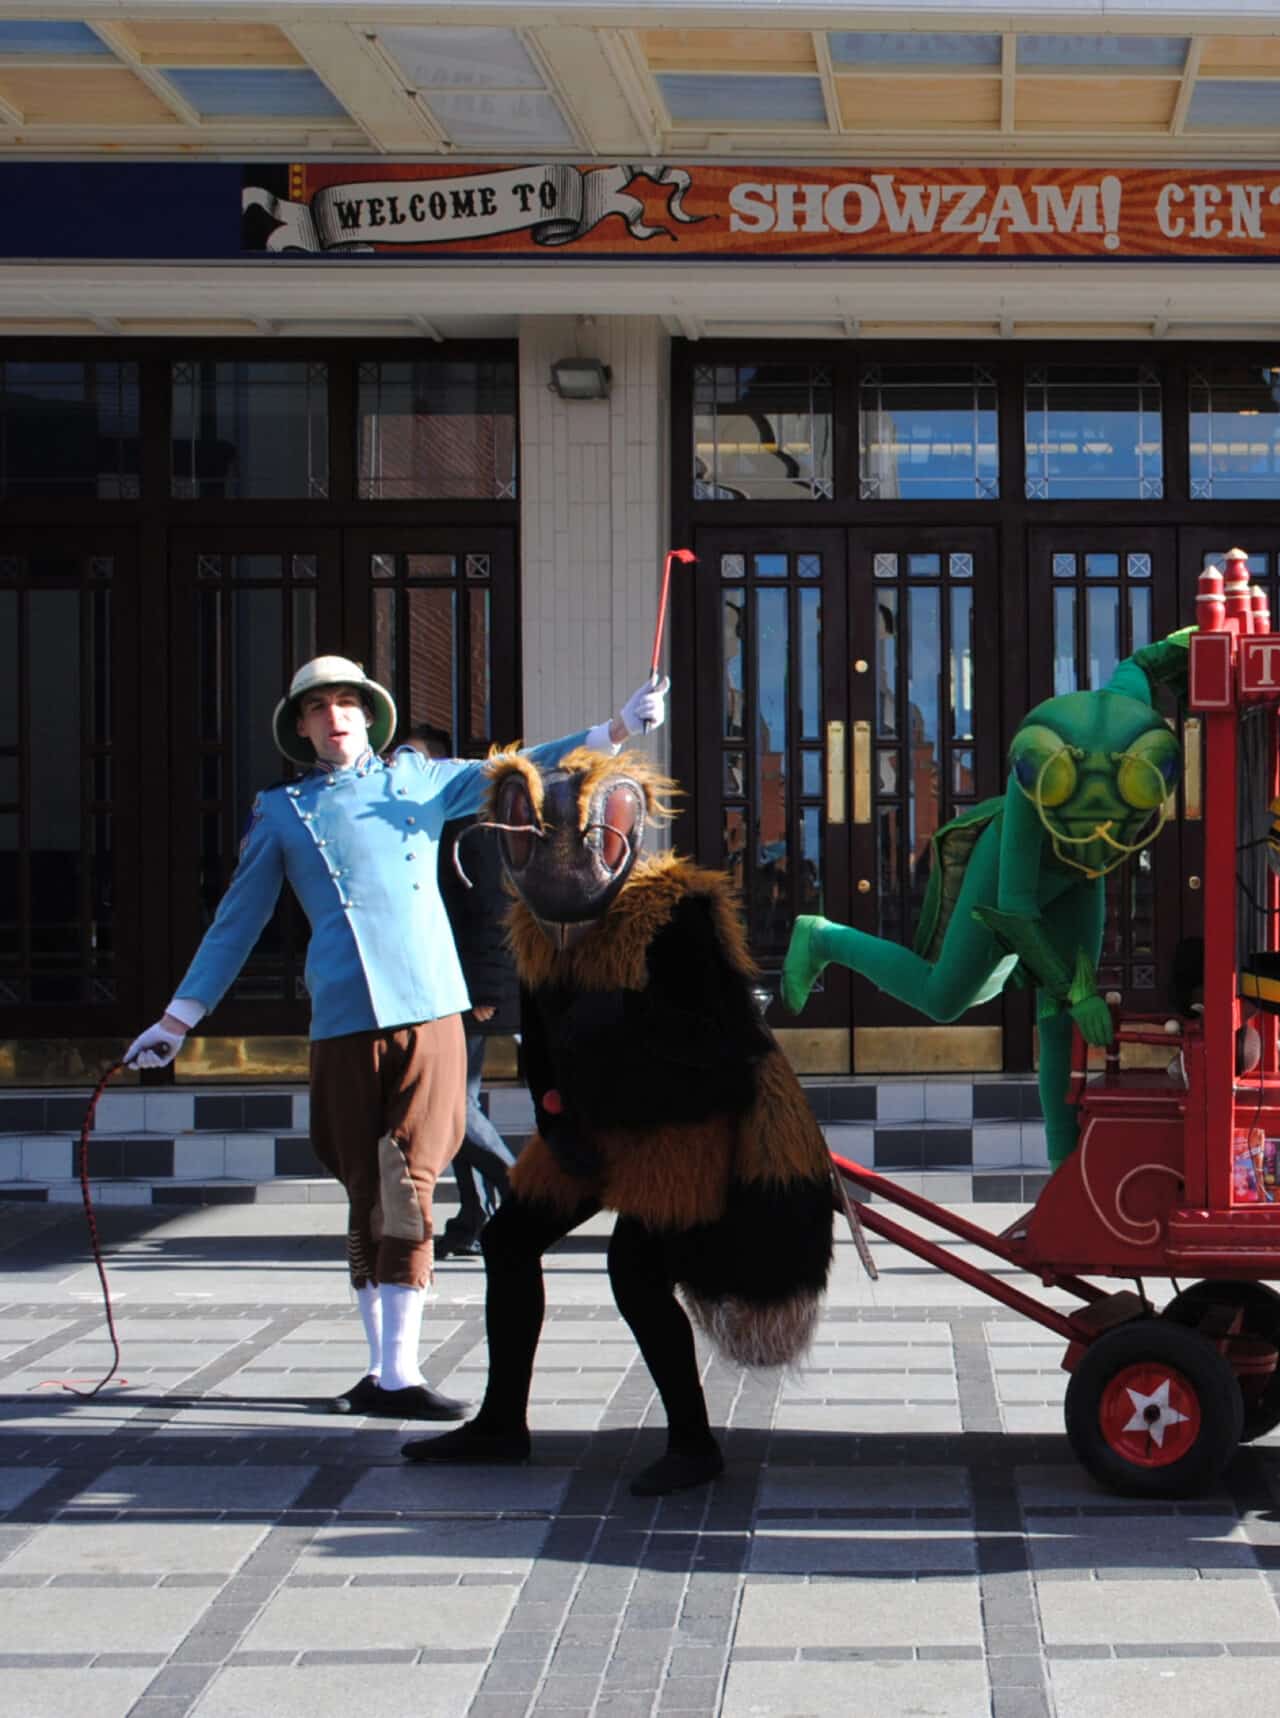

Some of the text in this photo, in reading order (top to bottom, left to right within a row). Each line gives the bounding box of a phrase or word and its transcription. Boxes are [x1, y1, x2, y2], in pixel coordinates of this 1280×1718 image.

[333, 180, 557, 229] WELCOME TO
[728, 174, 1123, 250] SHOWZAM!
